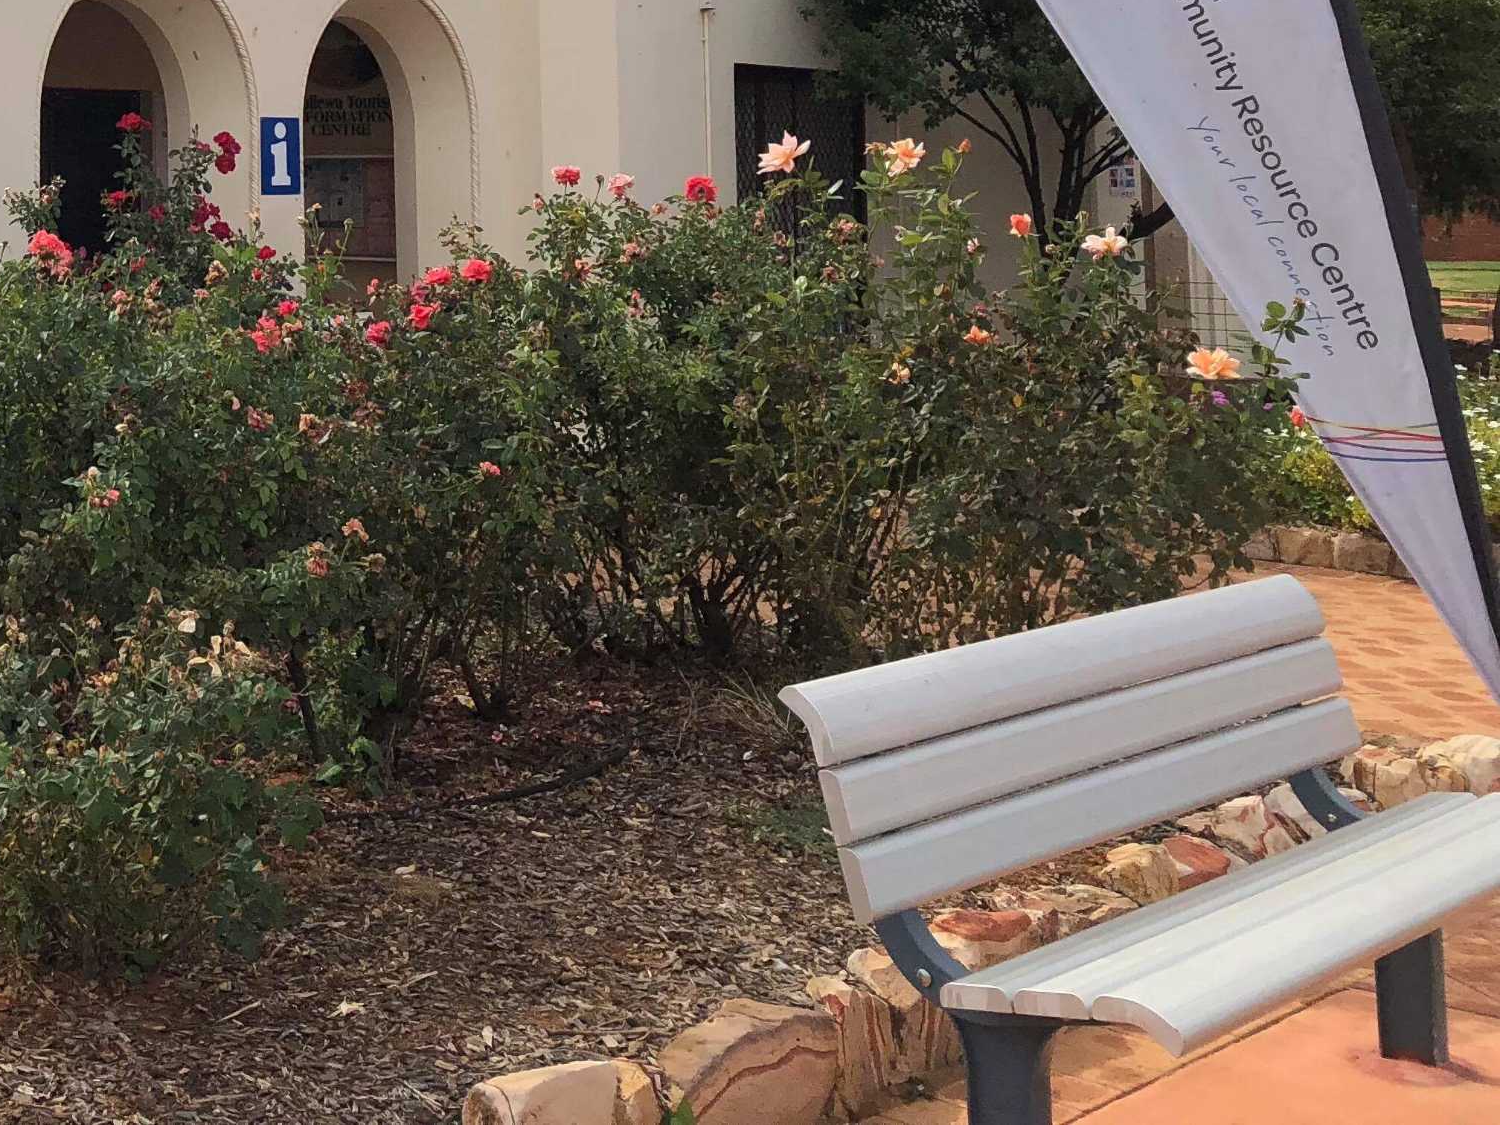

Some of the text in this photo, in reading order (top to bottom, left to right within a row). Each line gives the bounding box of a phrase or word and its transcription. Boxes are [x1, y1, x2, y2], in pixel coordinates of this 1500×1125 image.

[311, 123, 372, 136] CENTRE
[1186, 115, 1236, 168] Your
[1228, 175, 1285, 226] local
[1231, 95, 1318, 239] Resource
[1311, 242, 1379, 350] Centre
